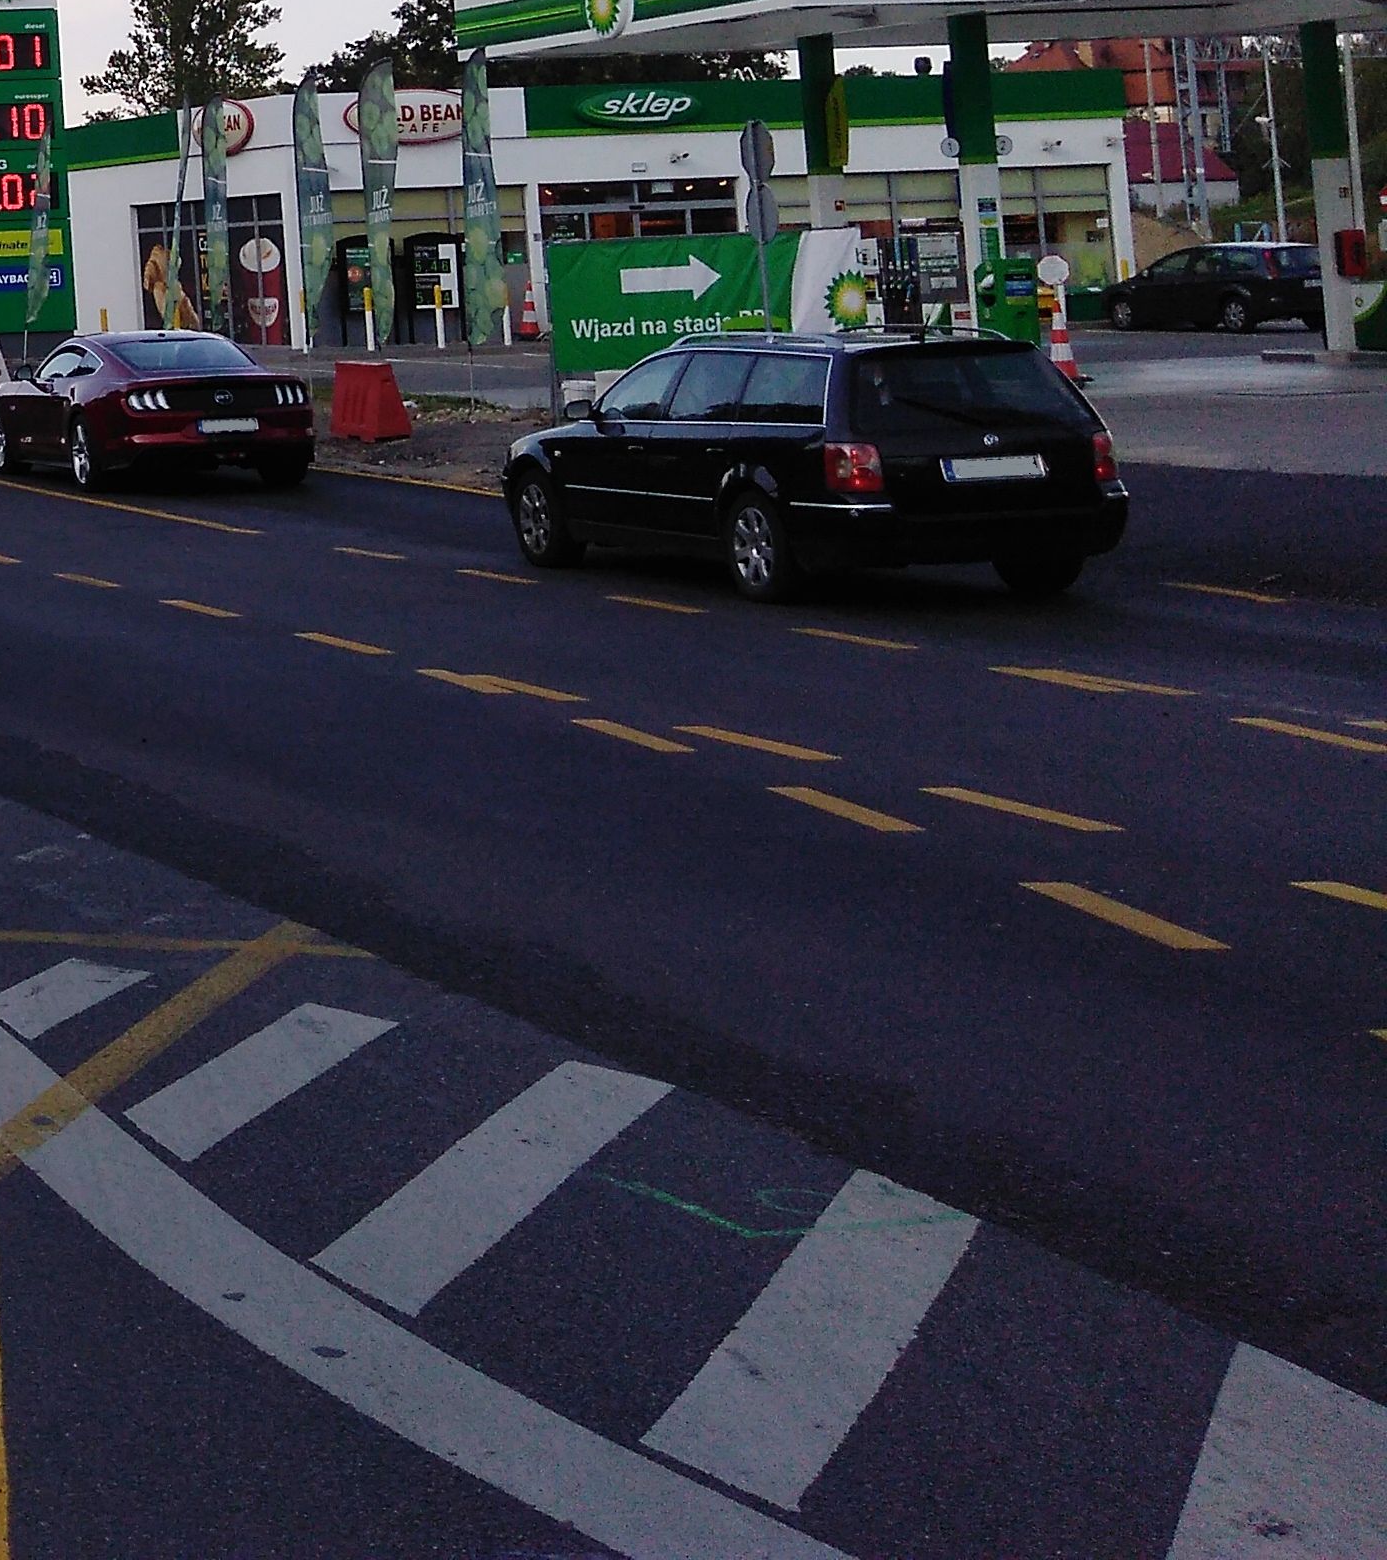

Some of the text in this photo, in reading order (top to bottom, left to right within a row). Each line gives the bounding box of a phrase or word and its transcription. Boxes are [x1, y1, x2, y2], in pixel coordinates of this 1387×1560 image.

[603, 91, 692, 121] sklep
[571, 317, 635, 342] Wjazd
[641, 320, 667, 335] na
